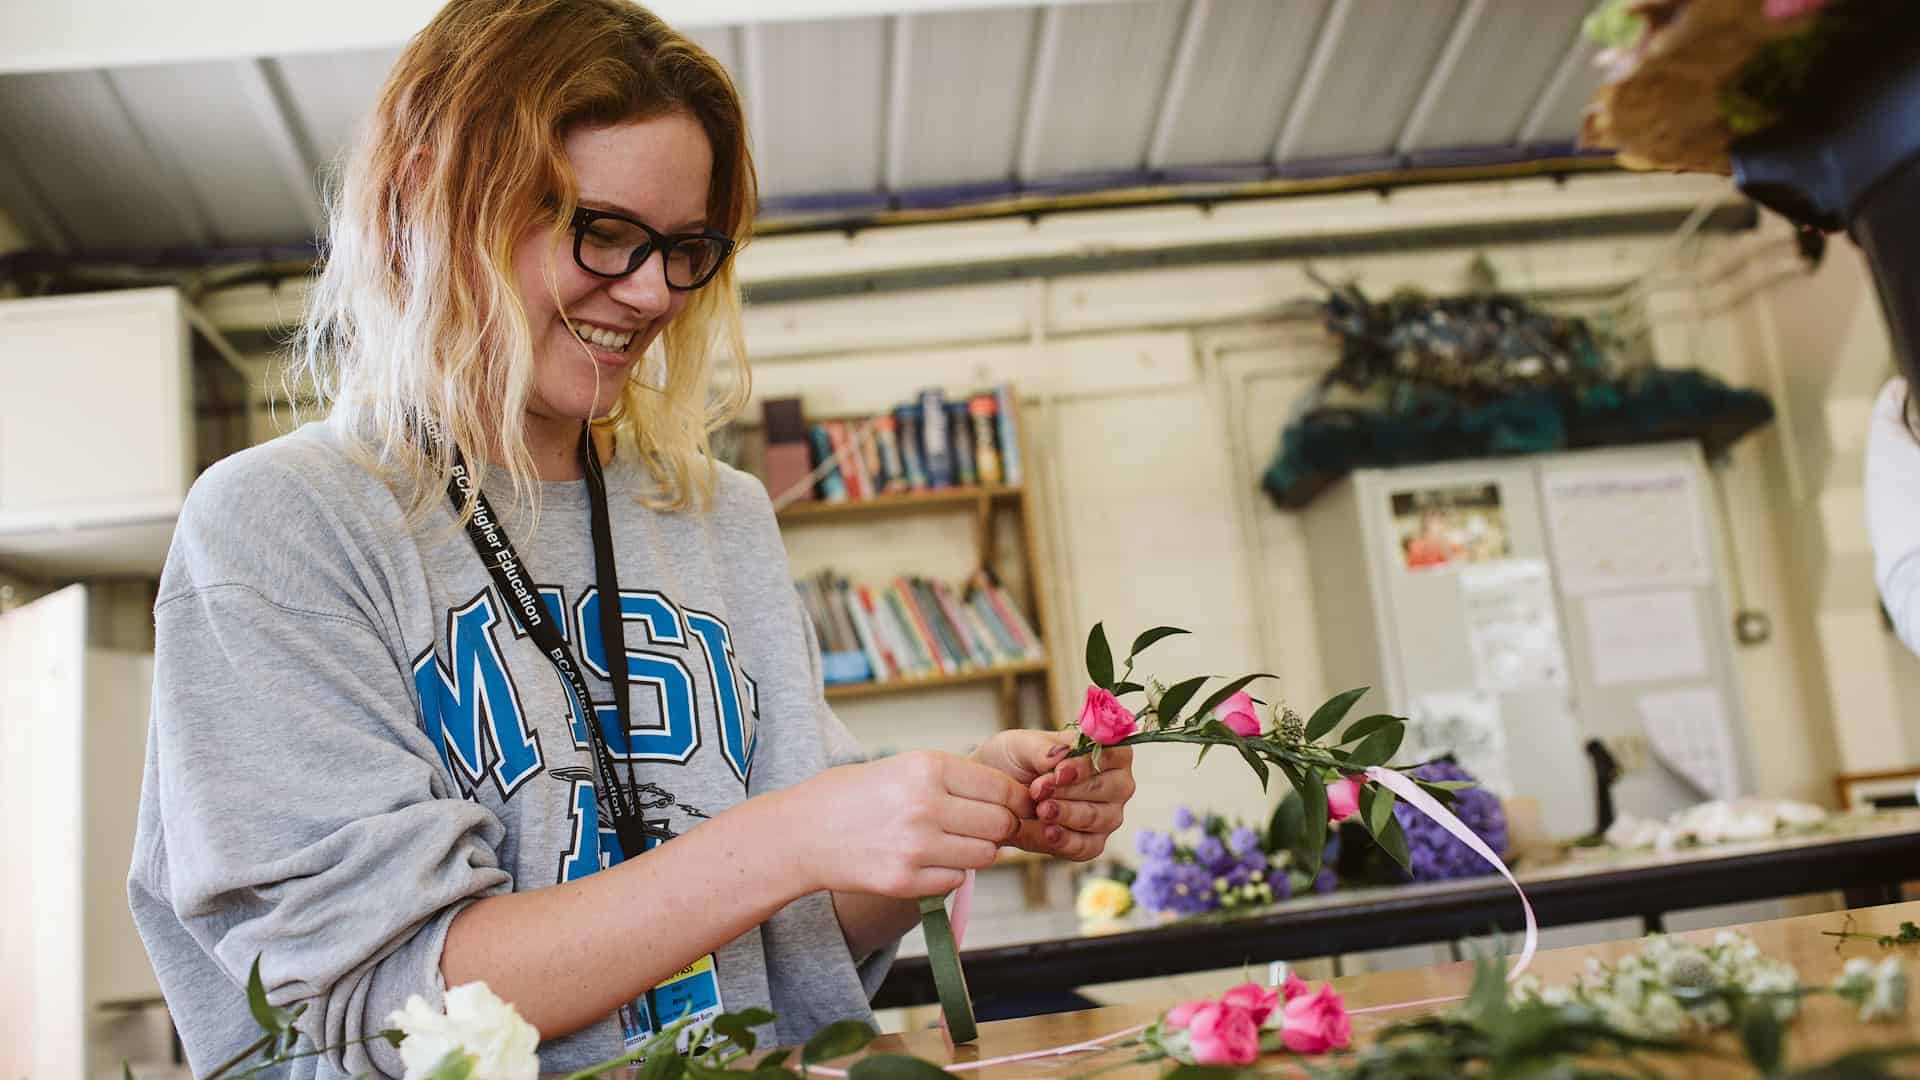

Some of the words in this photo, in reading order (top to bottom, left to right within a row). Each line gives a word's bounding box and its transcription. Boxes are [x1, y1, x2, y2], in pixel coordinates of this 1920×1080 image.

[452, 465, 473, 499] BCA
[474, 500, 502, 548] Higher
[496, 549, 541, 626] Education
[551, 647, 575, 680] BCA
